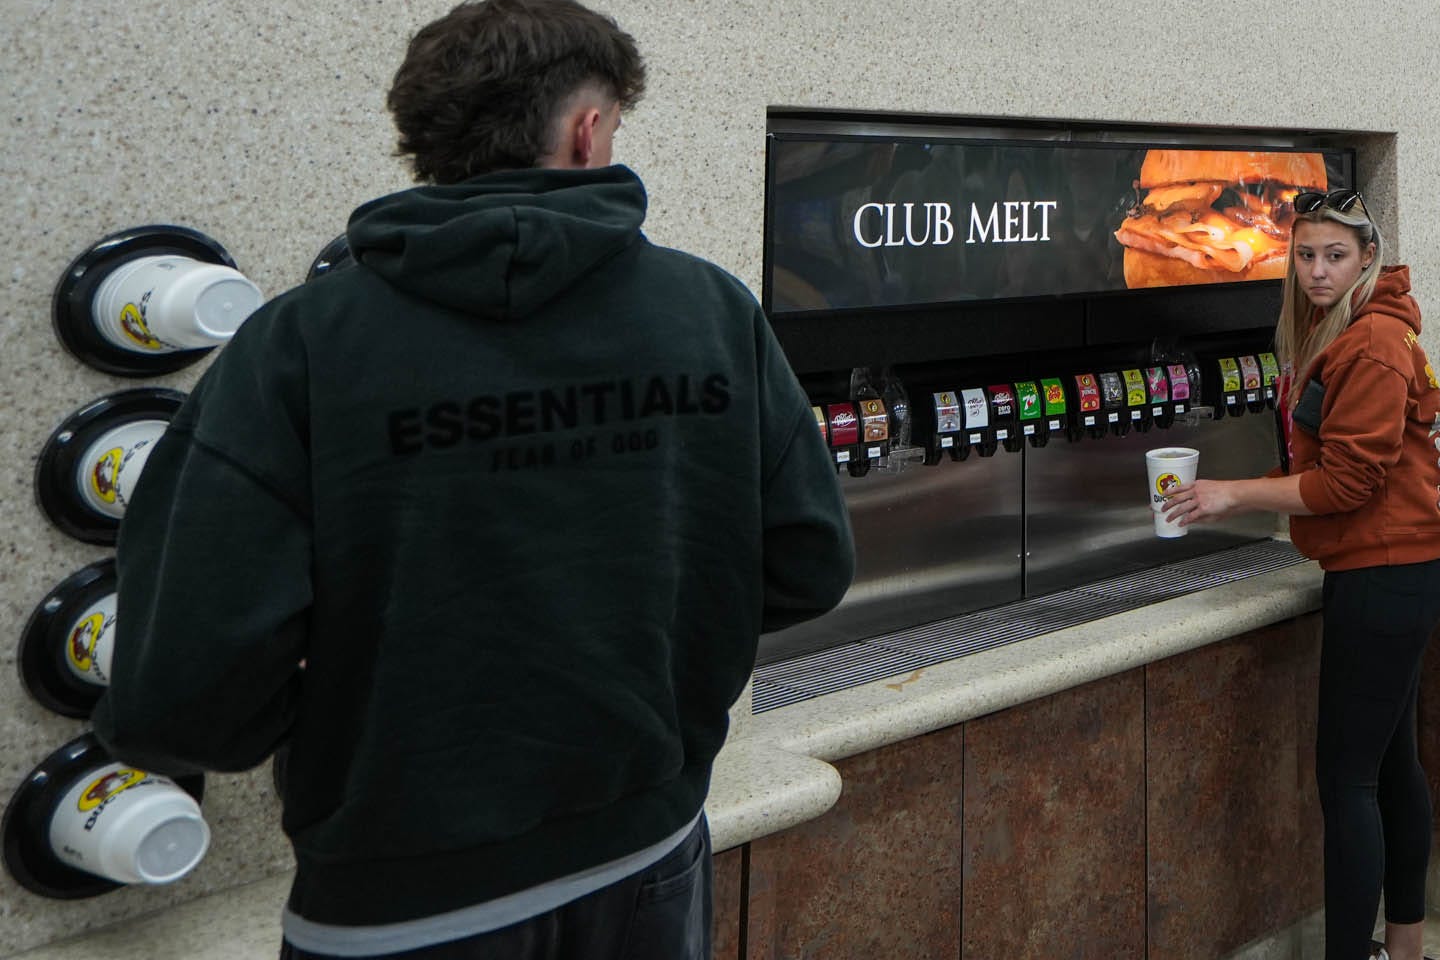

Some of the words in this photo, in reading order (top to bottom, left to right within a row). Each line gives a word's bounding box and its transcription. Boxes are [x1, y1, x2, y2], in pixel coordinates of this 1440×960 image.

[853, 202, 954, 248] CLUB
[965, 201, 1057, 244] MELT
[387, 372, 732, 457] ESSENTIALS
[491, 448, 556, 472] FEAR
[570, 439, 598, 461] OF
